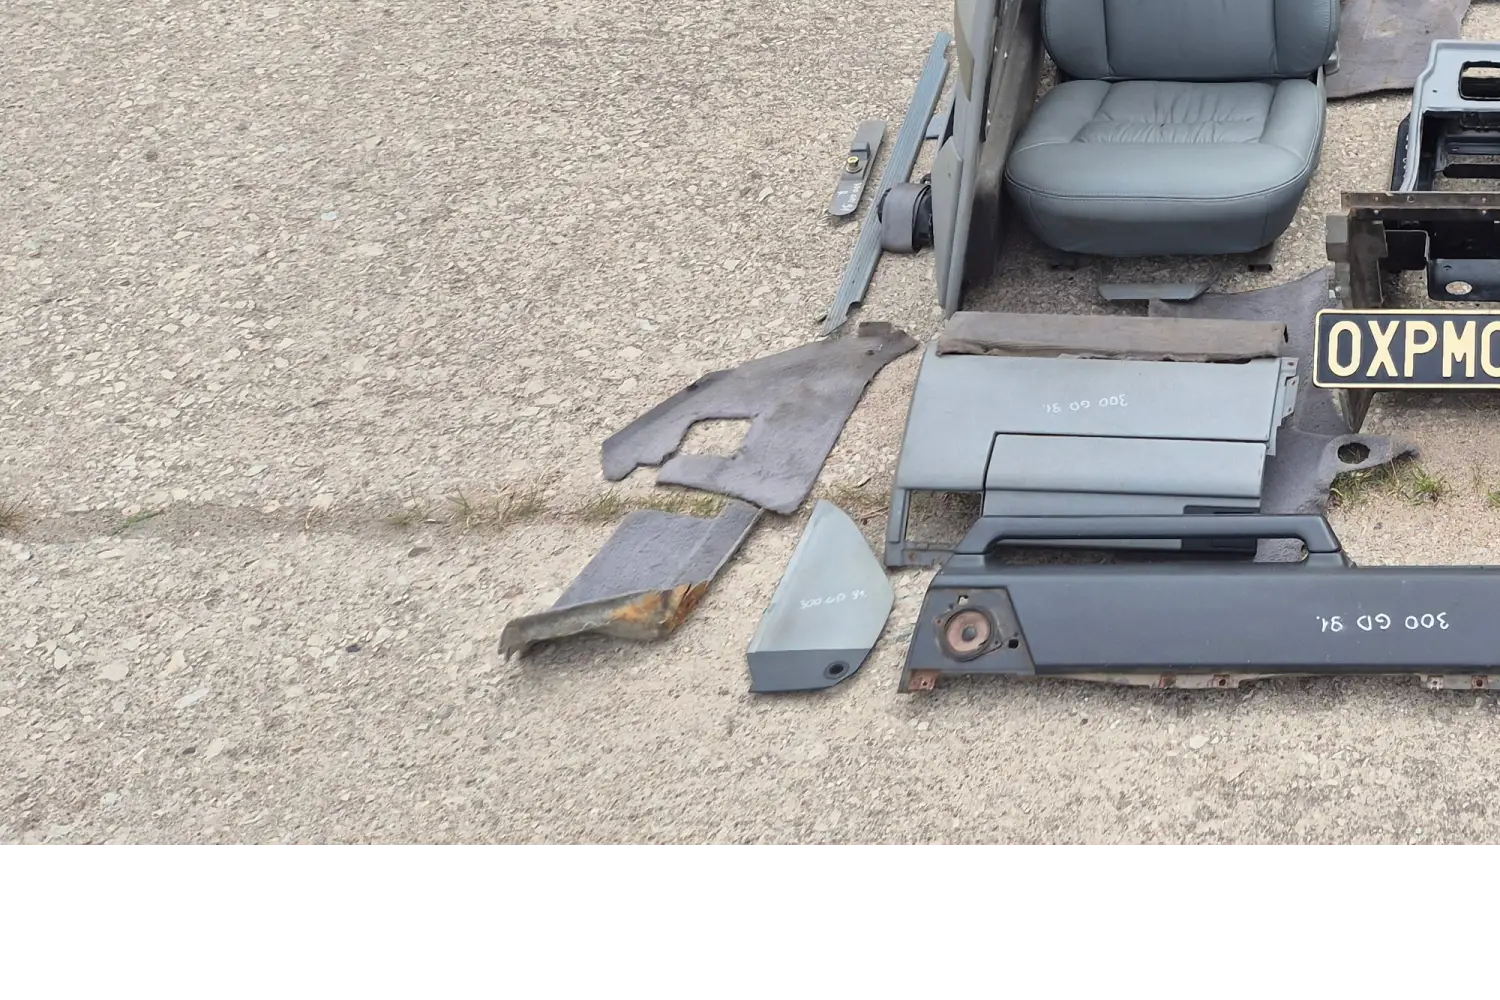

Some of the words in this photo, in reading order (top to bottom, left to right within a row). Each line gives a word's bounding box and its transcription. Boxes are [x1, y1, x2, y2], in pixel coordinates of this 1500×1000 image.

[1097, 393, 1129, 407] 300
[1356, 612, 1392, 632] GD
[1404, 611, 1450, 631] 300
